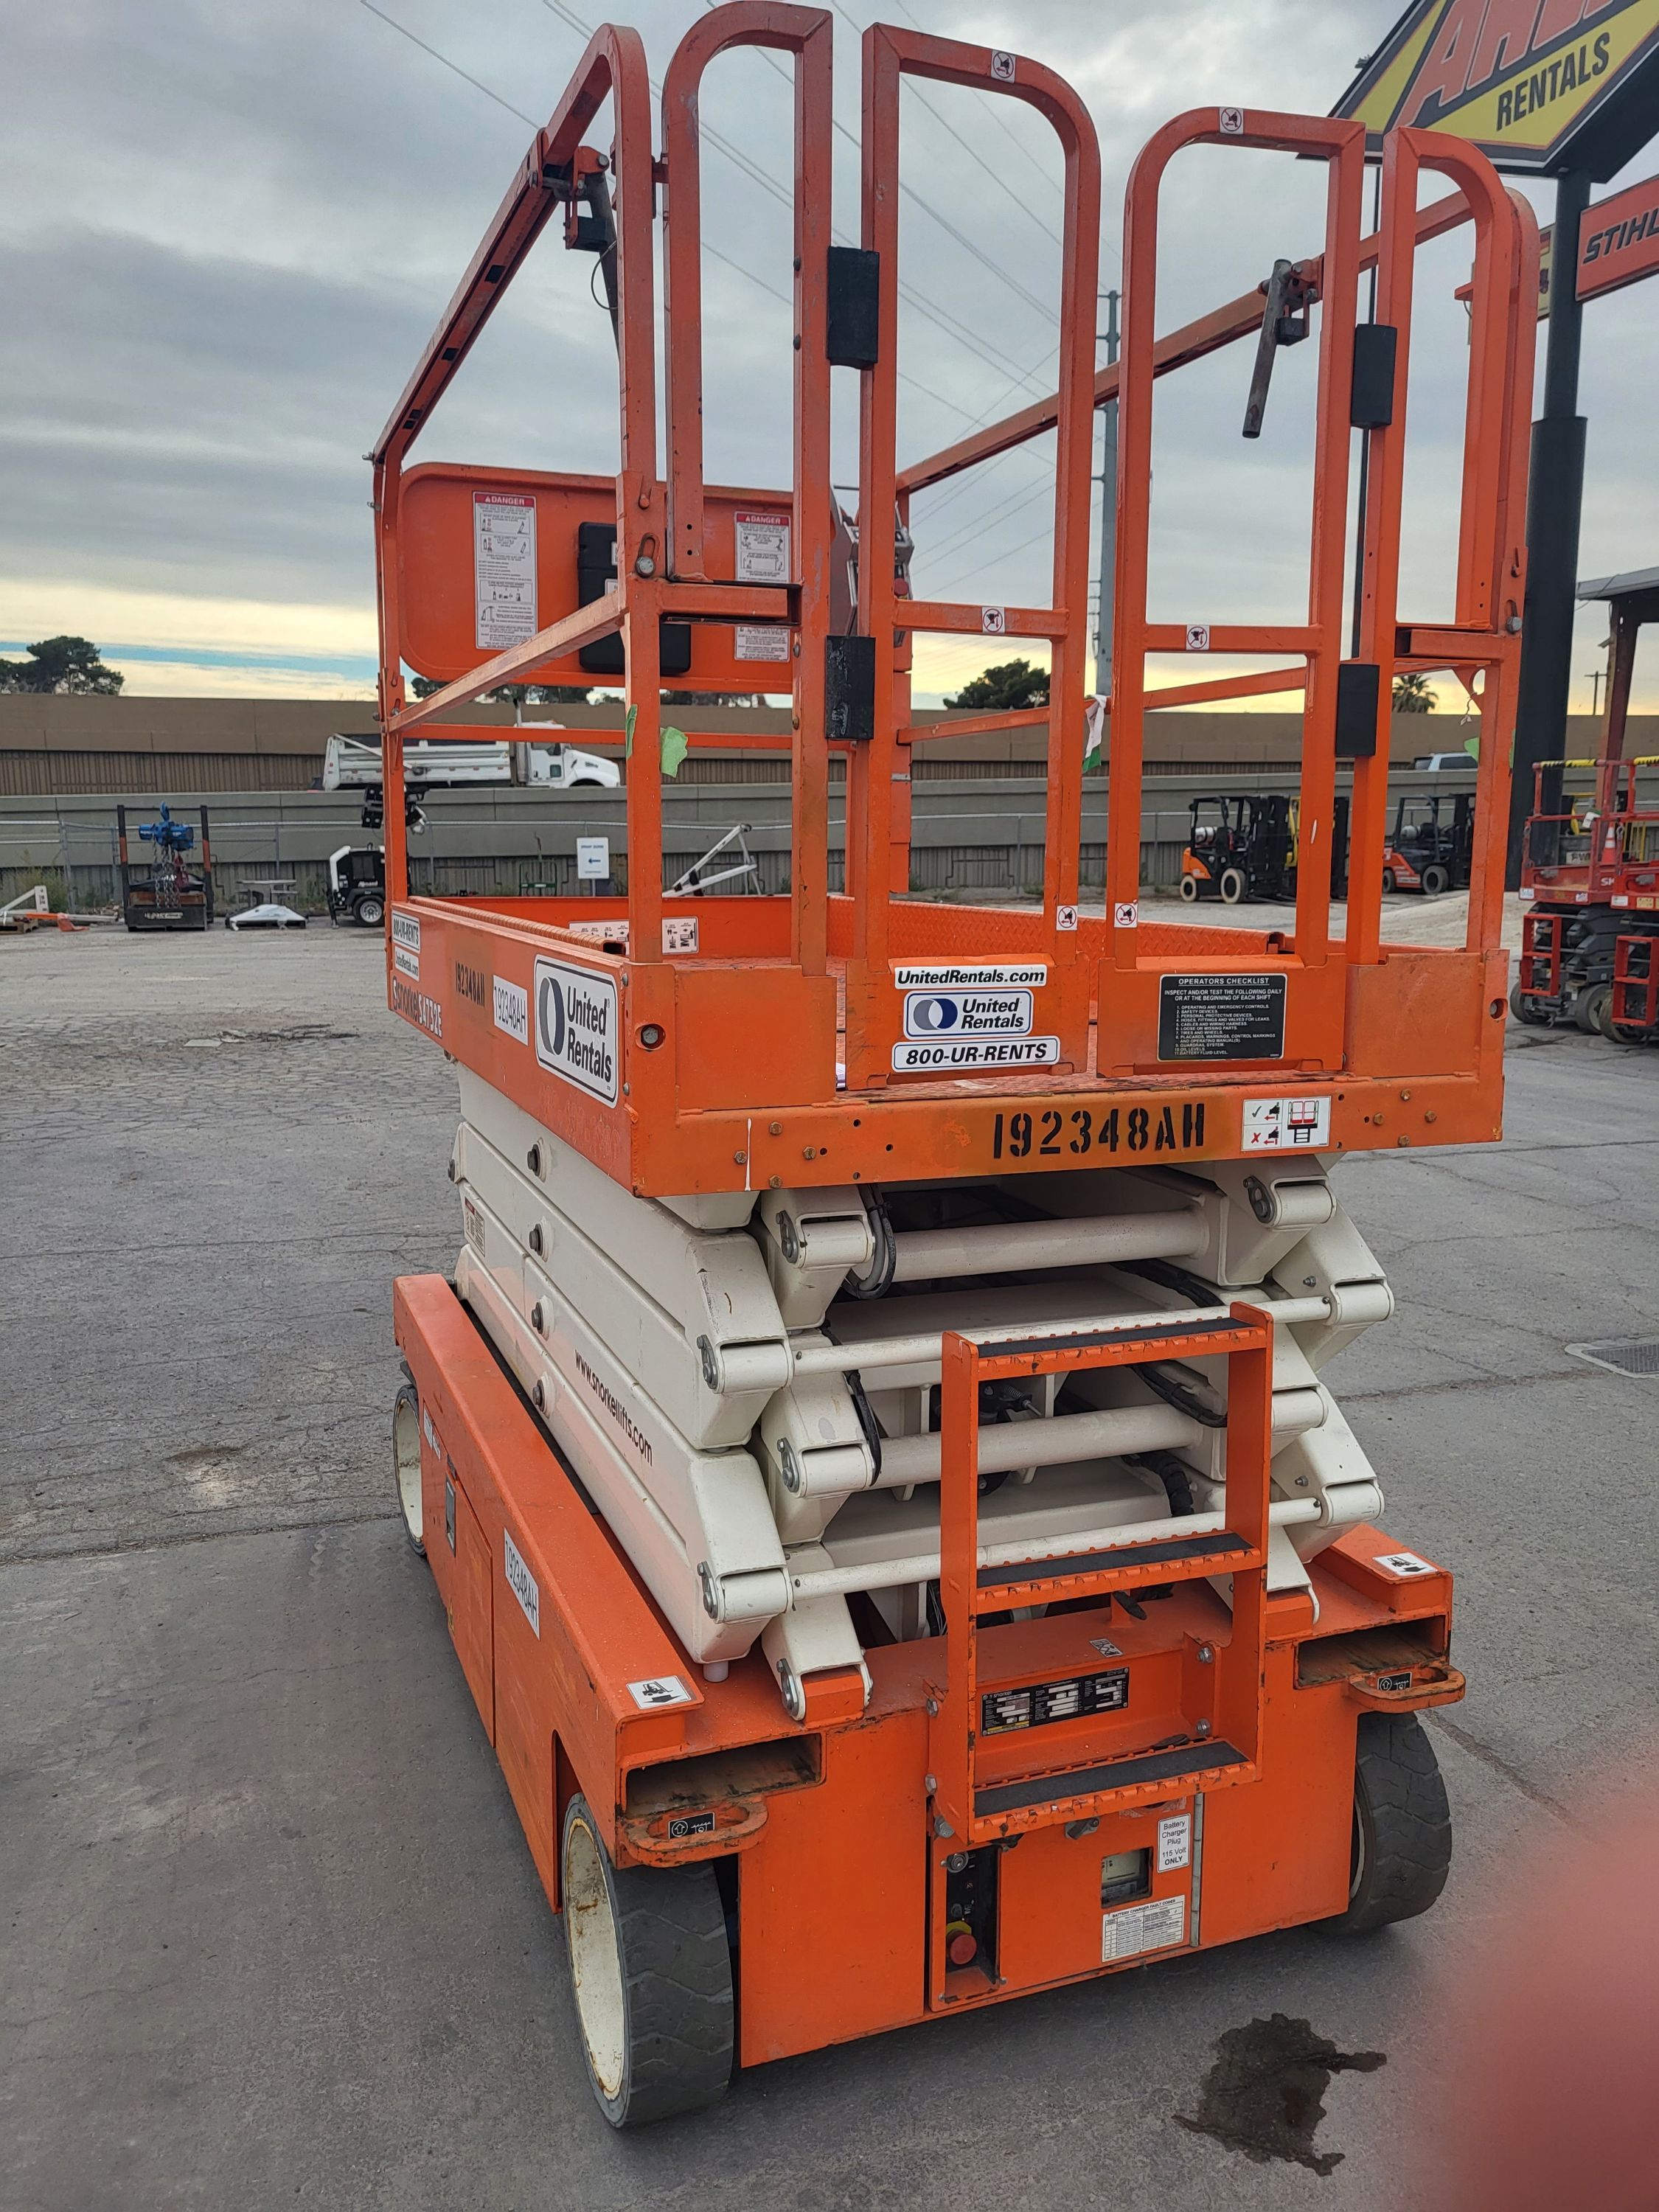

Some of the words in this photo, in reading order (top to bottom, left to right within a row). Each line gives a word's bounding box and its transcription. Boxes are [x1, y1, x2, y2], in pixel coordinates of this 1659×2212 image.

[1496, 32, 1610, 131] RENTALS
[1582, 209, 1659, 265] STIHL
[491, 496, 525, 505] DANGER
[751, 515, 781, 524] DANGER
[455, 961, 485, 1007] 192348AH
[897, 969, 1045, 984] UnitedRentals.com
[494, 986, 526, 1035] 192348AH
[567, 985, 608, 1037] United
[962, 998, 1020, 1013] United
[961, 1013, 1024, 1029] Rentals
[567, 1026, 612, 1083] Rentals
[905, 1043, 1047, 1065] 800-UR-RENTS
[993, 1103, 1205, 1158] 192348AH
[574, 1349, 653, 1467] www.snorkellifts.com
[505, 1540, 538, 1627] 192348AH
[1162, 1828, 1187, 1838] Charger
[1164, 1820, 1186, 1830] Battery
[1167, 1837, 1181, 1846] Plug
[1164, 1855, 1183, 1865] ONLY
[1112, 1910, 1130, 1918] BATTERY
